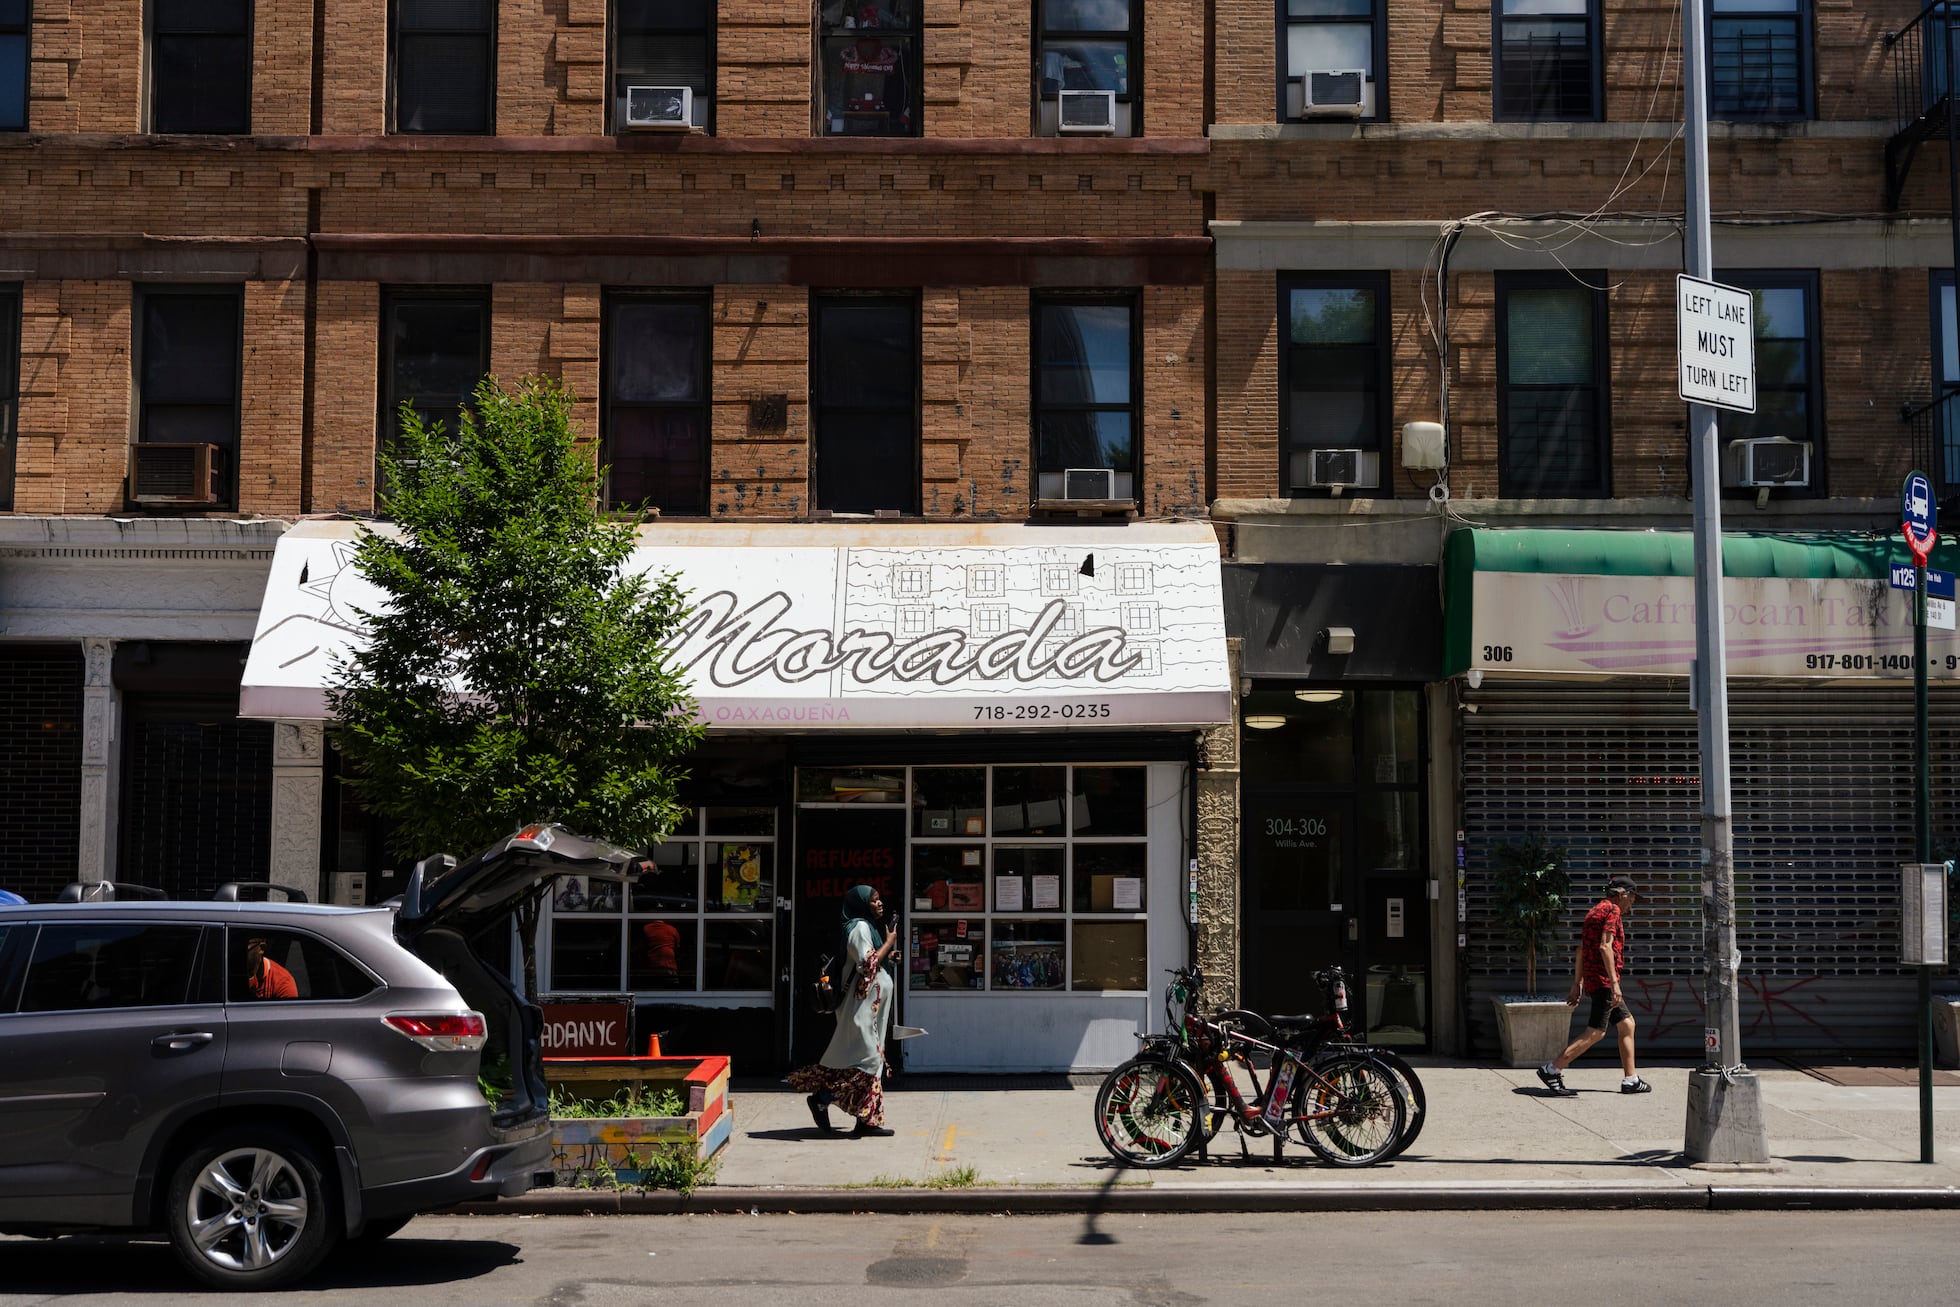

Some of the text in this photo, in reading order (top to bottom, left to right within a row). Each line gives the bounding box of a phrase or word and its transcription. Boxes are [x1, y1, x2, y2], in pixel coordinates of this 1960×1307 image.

[1685, 293, 1746, 325] LEFT LANE
[1698, 330, 1735, 358] MUST
[1686, 365, 1748, 394] TURN LEFT
[1892, 567, 1915, 588] M125
[1602, 594, 1807, 626] Cafrcan
[1819, 597, 1891, 627] Tax
[642, 588, 1143, 689] Morada
[1483, 645, 1513, 663] 306
[1945, 655, 1960, 670] 9
[716, 703, 850, 721] OAXAQUEÑA
[973, 704, 1111, 721] 718-292-0235
[1265, 818, 1327, 836] 304-306
[1275, 839, 1317, 848] Willis Ave.
[806, 847, 896, 870] REFUGEES
[805, 875, 894, 897] WELCE
